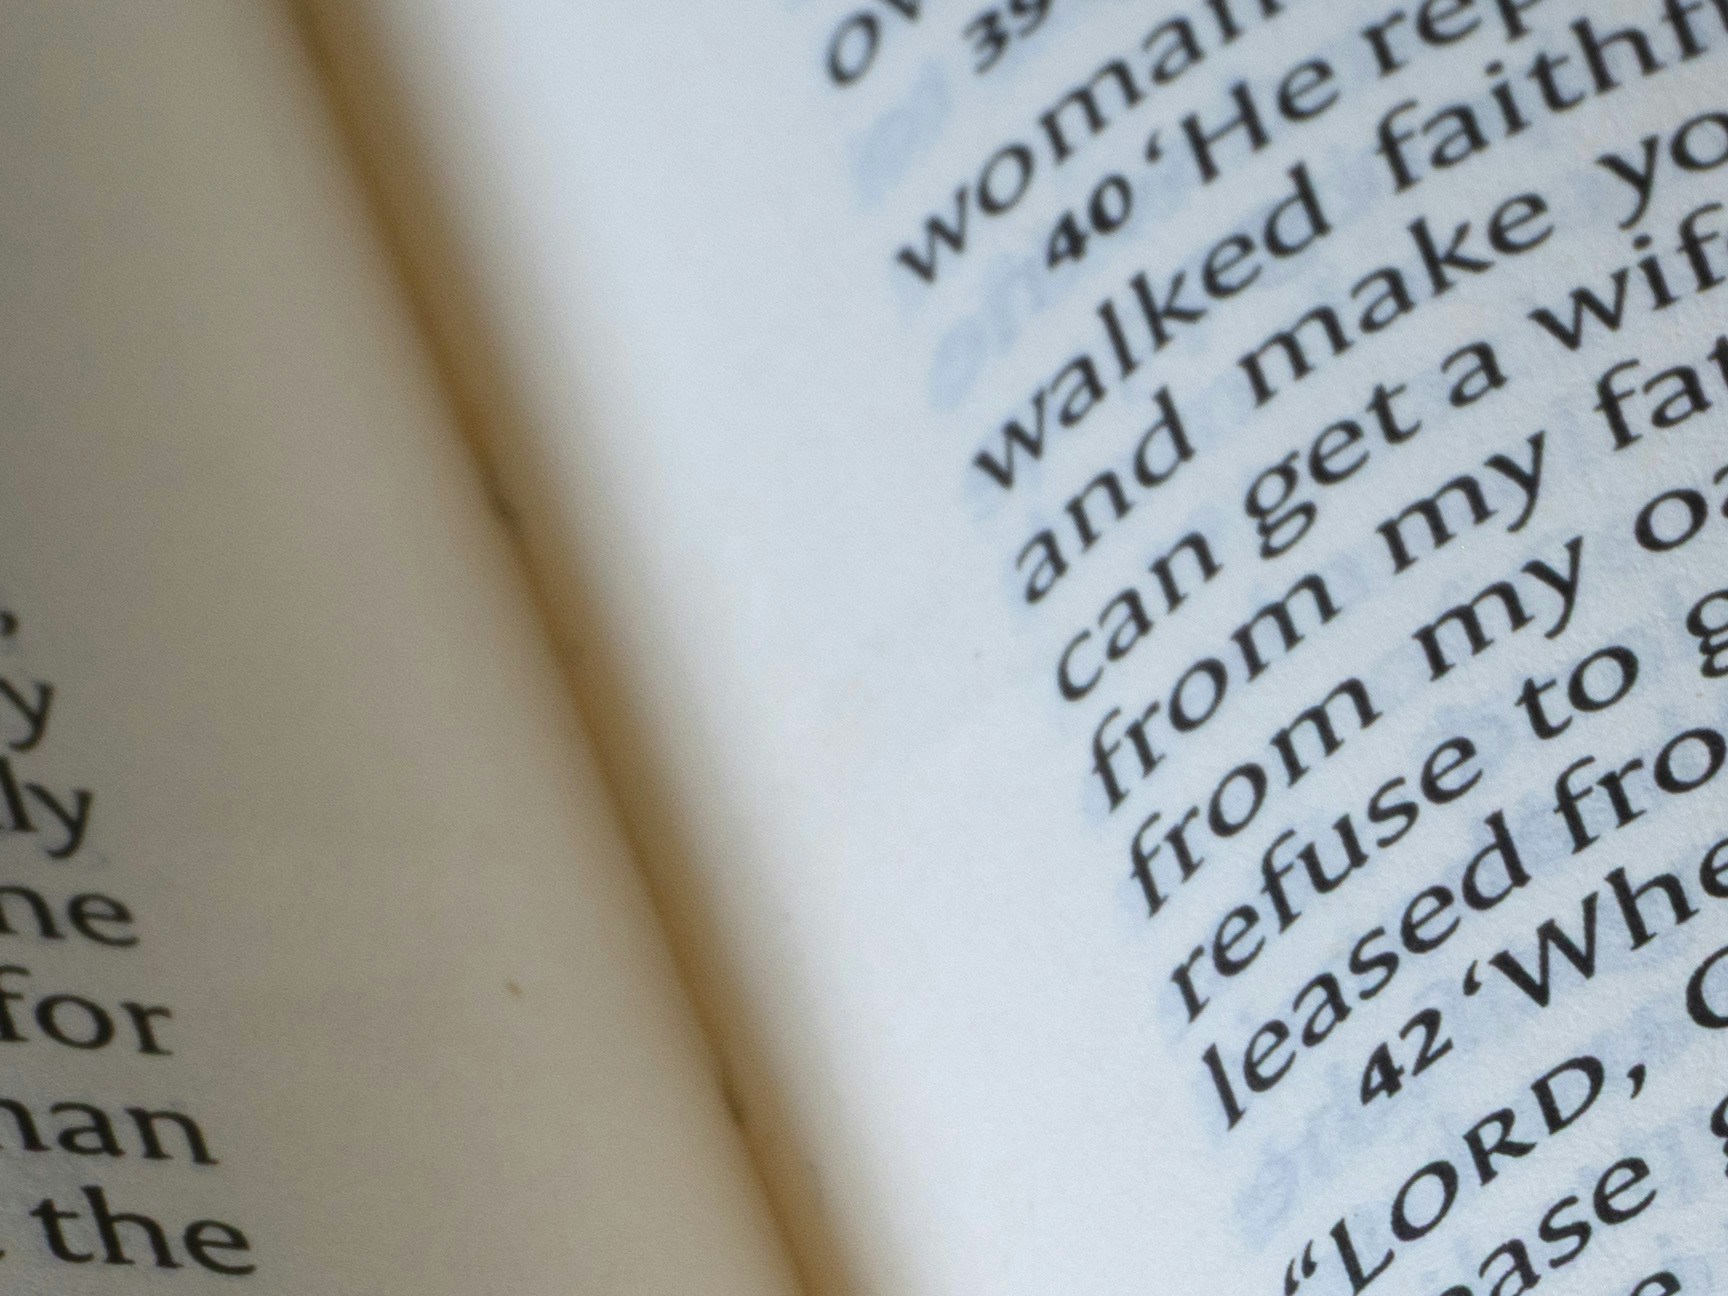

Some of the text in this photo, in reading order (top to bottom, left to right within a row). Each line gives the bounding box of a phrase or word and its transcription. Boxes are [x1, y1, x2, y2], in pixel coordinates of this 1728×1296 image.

[971, 160, 1334, 491] walked
[1015, 385, 1197, 606] and
[1236, 191, 1556, 409] make
[1055, 530, 1223, 704] can
[1242, 382, 1423, 562] get
[1439, 339, 1510, 410] a
[1128, 675, 1384, 919] from
[1410, 533, 1585, 684] my
[1168, 734, 1485, 1025] refuse
[1513, 643, 1642, 743] to
[1199, 807, 1534, 1132] leased
[26, 1182, 258, 1279] the
